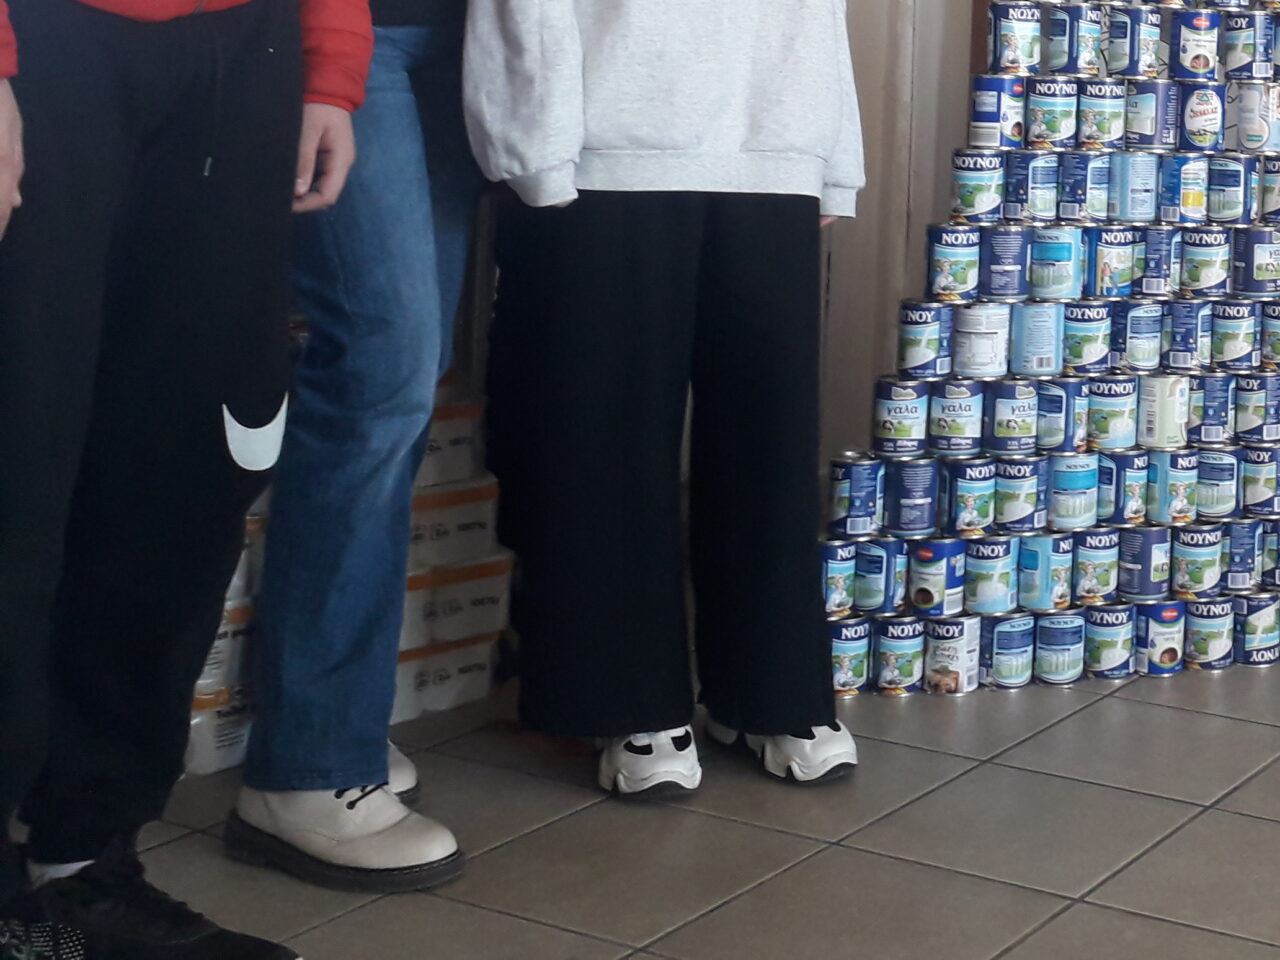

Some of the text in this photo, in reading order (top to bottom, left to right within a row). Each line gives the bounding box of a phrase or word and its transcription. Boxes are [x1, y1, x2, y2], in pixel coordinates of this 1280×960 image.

[1008, 8, 1041, 20] NOYN
[1228, 17, 1249, 27] NOY
[953, 156, 1002, 169] NOYNOY
[941, 232, 980, 244] NOYN
[1101, 232, 1132, 243] NOYN
[903, 310, 936, 323] YNOY
[1241, 379, 1261, 390] NOY
[887, 403, 919, 416] γάλα
[940, 402, 973, 415] γάλα
[1177, 456, 1199, 469] NOY
[1247, 451, 1272, 462] NOY
[1000, 464, 1034, 477] YNOY
[1086, 535, 1118, 547] NOYN
[969, 544, 1007, 558] YNOY
[888, 623, 925, 637] NOYN
